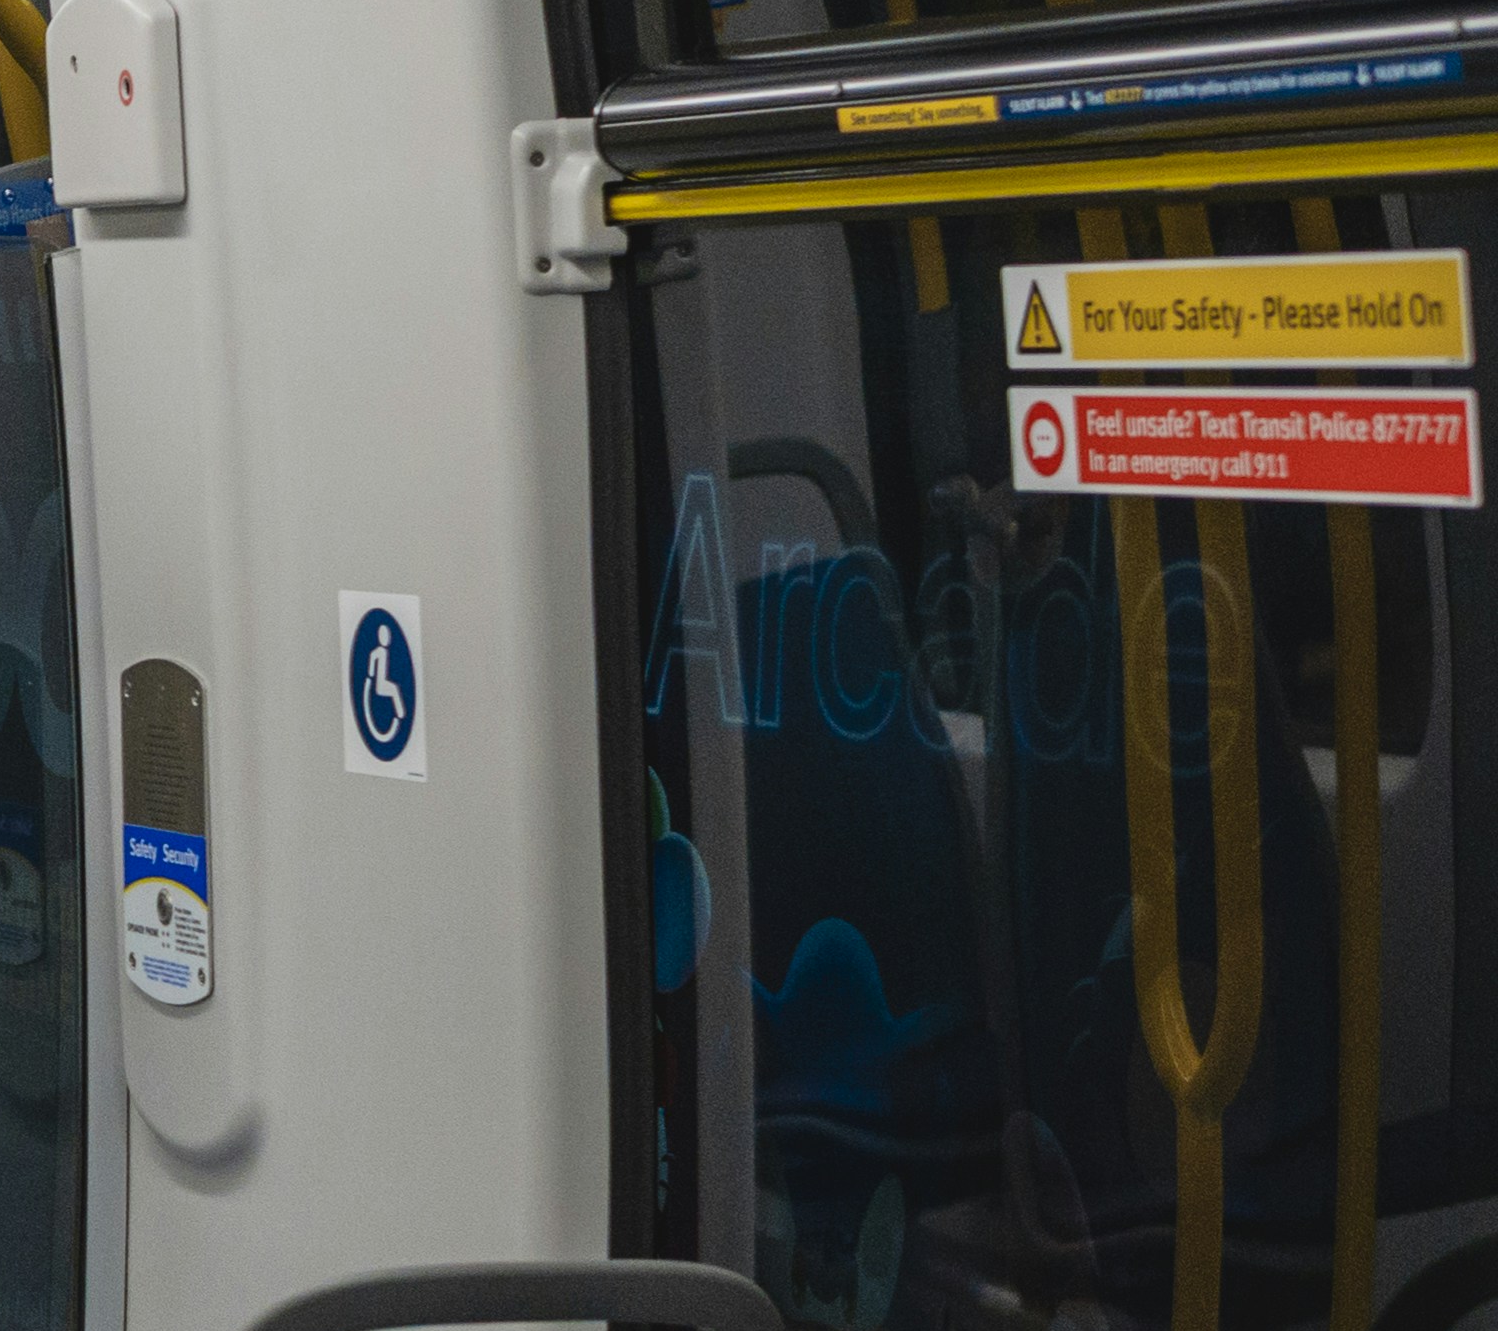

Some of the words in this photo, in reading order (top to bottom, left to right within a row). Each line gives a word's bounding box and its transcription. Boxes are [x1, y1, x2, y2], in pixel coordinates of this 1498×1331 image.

[1083, 300, 1115, 332] For
[1118, 299, 1167, 332] Your
[1172, 297, 1243, 339] Safety
[1262, 295, 1340, 330] Please
[1346, 292, 1402, 328] Hold
[1409, 292, 1444, 327] On
[1085, 409, 1121, 437] Feel
[1125, 410, 1194, 438] unsafe?
[1196, 411, 1239, 440] Text
[1241, 411, 1305, 441] Transit
[1309, 411, 1369, 442] Police
[1371, 414, 1460, 444] 87-77-77
[1088, 450, 1106, 471] In
[1108, 454, 1129, 472] an
[1131, 454, 1220, 481] emergency
[1221, 451, 1252, 478] call
[1253, 453, 1289, 479] 911
[644, 470, 1244, 777] Arcade
[129, 837, 158, 865] Safety
[162, 843, 200, 873] Security
